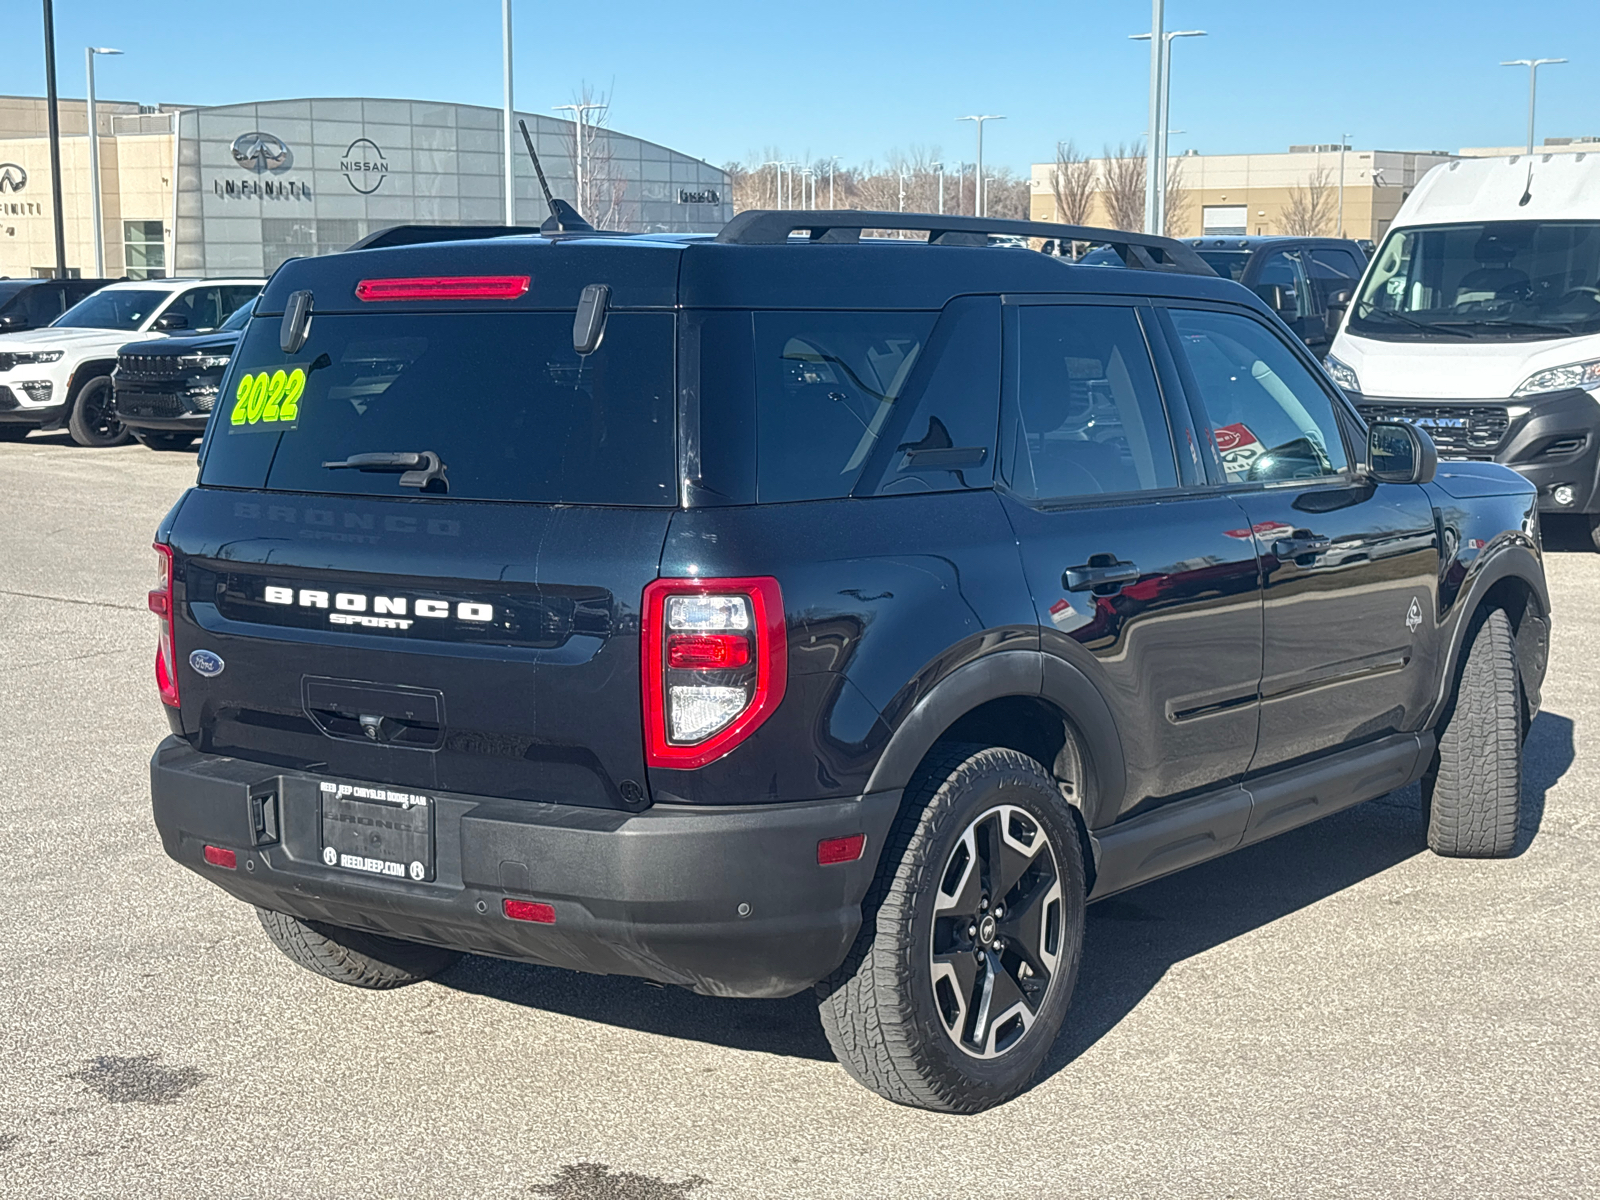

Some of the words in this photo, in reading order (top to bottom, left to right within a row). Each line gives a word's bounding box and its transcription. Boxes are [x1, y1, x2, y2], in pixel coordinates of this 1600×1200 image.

[340, 161, 388, 172] NISSAN
[214, 179, 306, 196] INFINITI
[0, 203, 41, 216] INITI
[231, 368, 306, 426] 2022
[265, 585, 493, 622] BRONCO
[329, 613, 413, 630] SPORT
[338, 784, 353, 796] JEEP
[353, 786, 386, 801] CHRYSLER
[387, 791, 409, 803] DODGE
[410, 795, 427, 806] RAM
[341, 854, 405, 877] REEDJEEP.COM
